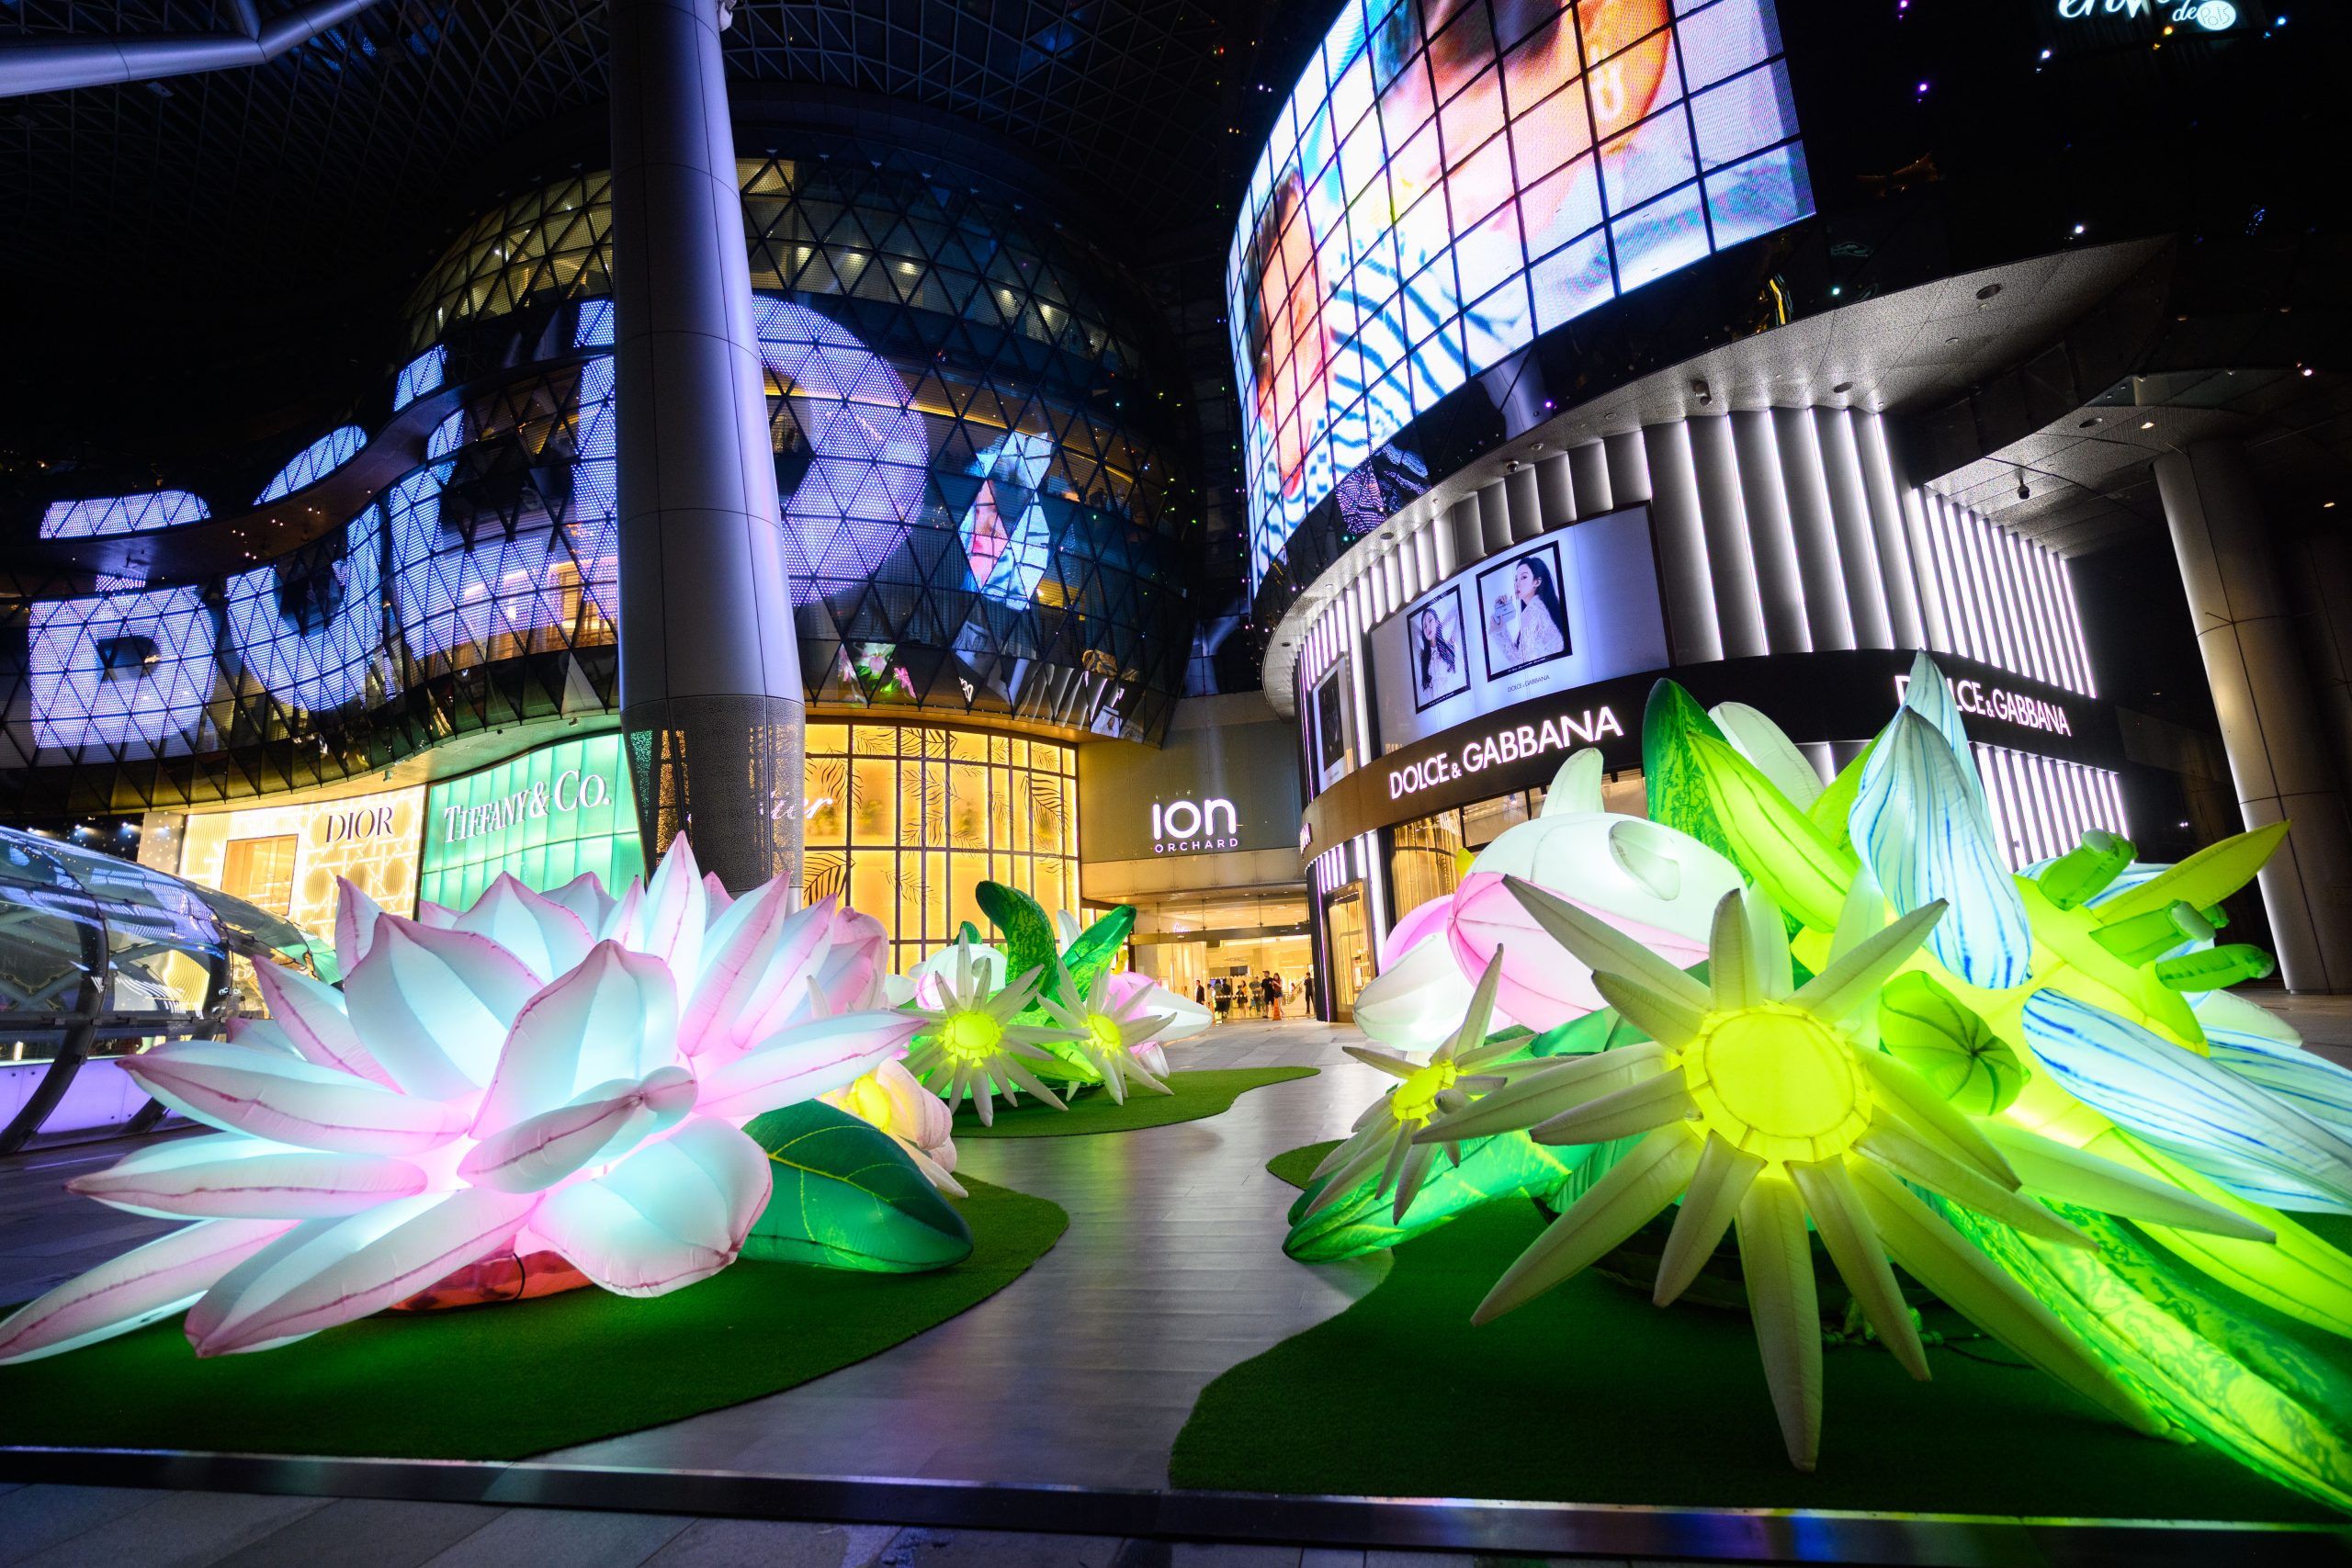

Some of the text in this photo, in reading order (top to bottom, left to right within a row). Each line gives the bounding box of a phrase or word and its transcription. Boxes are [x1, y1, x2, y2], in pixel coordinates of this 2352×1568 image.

[1894, 675, 1986, 716] DLCE
[1992, 688, 2073, 737] GABBANA
[1388, 752, 1451, 800] DOLCE
[1463, 706, 1624, 773] GABBANA
[325, 806, 394, 843] DIOR
[444, 788, 532, 843] TIFFANY
[529, 781, 549, 818] &
[1155, 838, 1238, 853] ORCHARD
